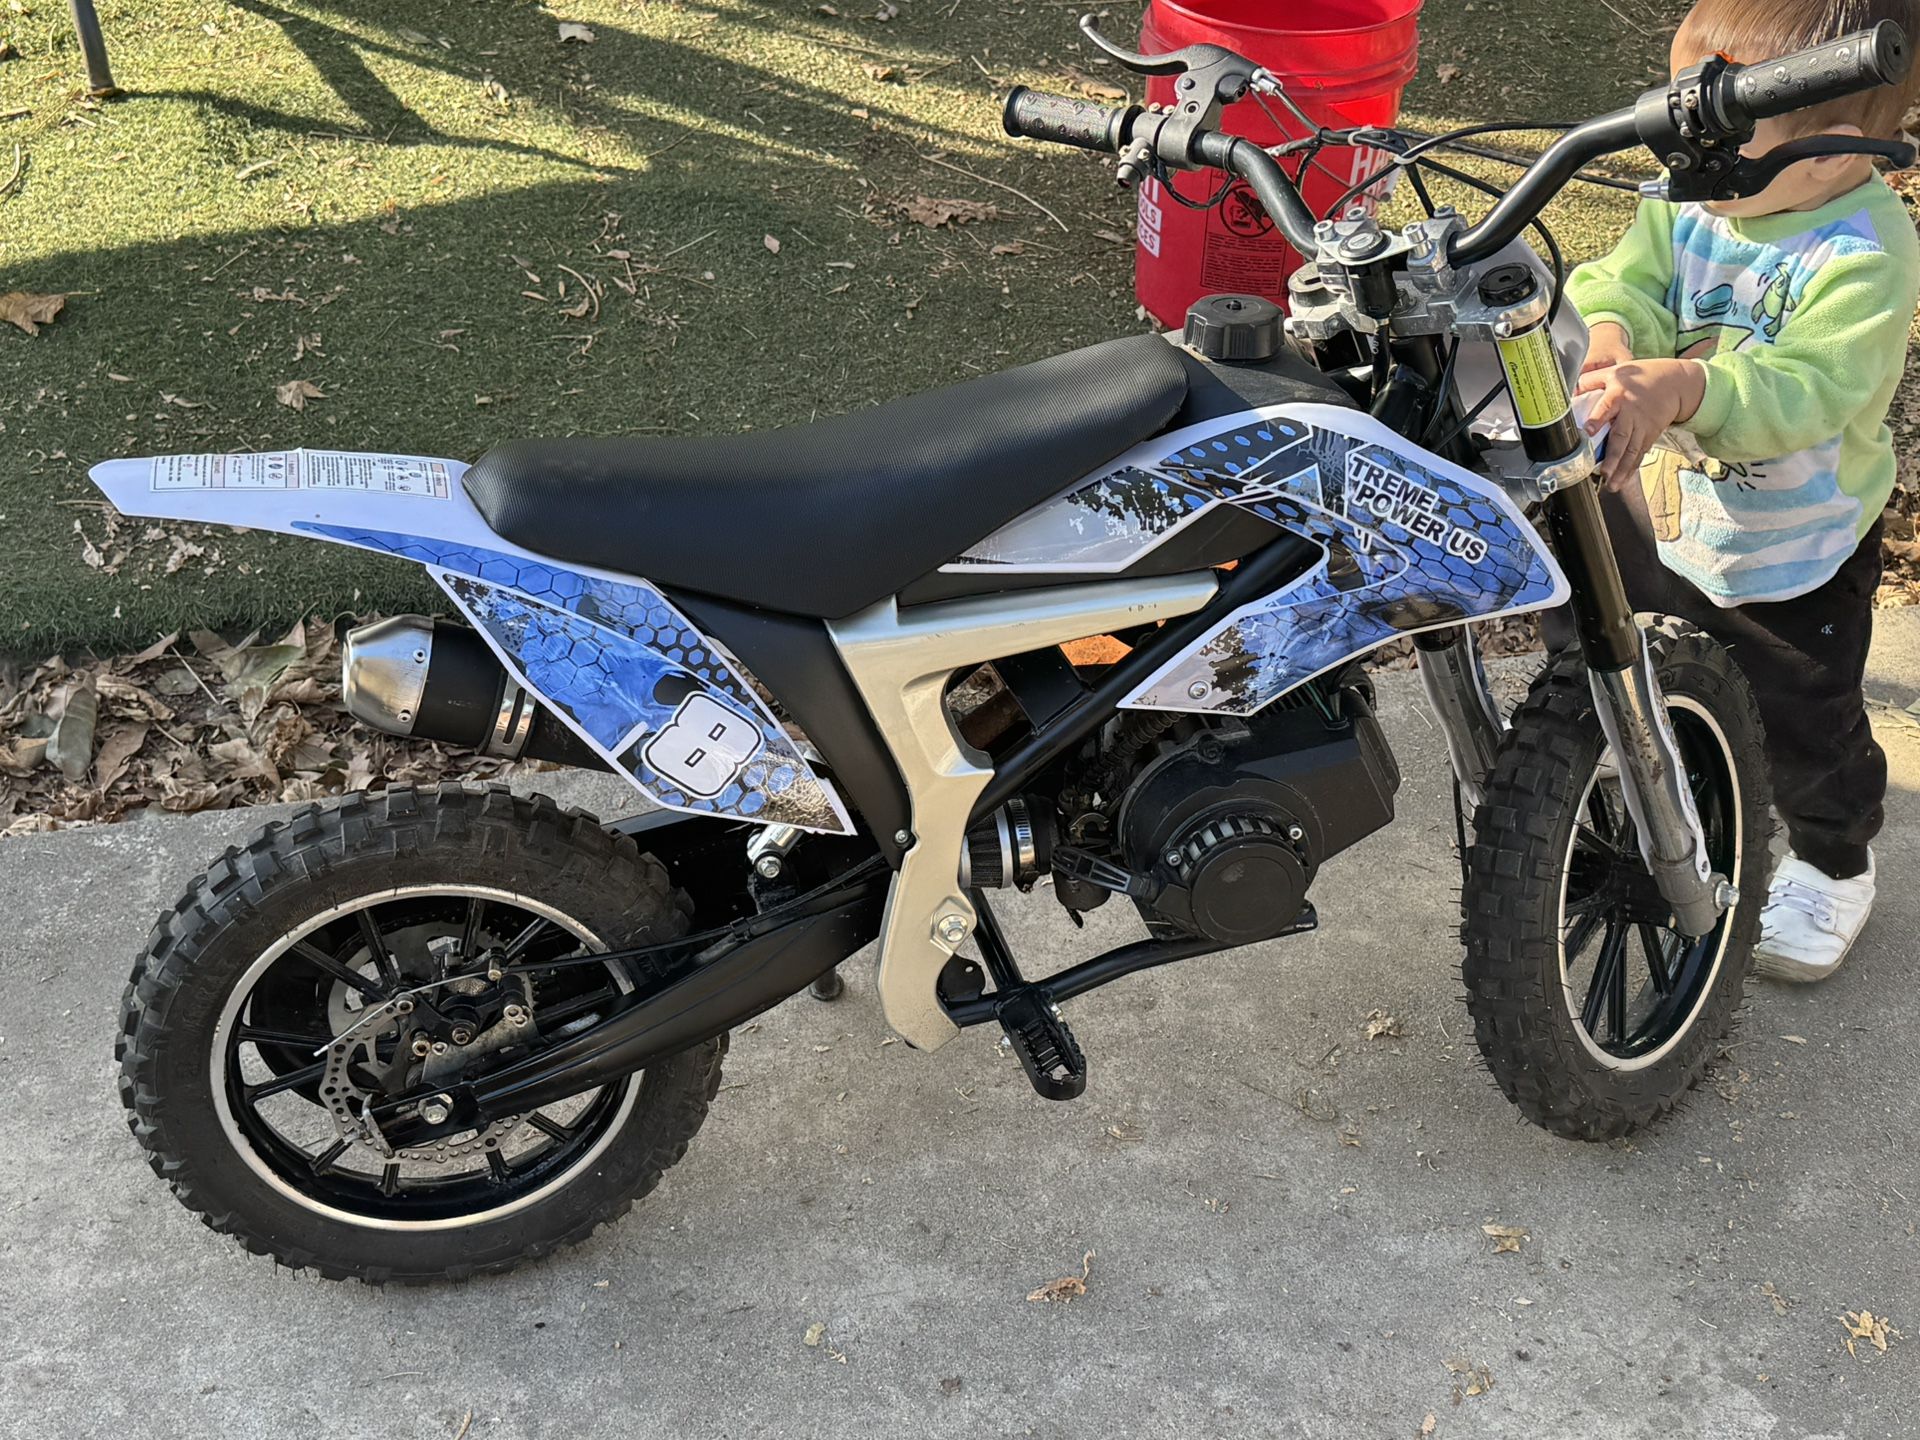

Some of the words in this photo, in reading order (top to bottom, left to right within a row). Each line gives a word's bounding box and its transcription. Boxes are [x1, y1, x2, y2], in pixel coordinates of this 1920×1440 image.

[1351, 456, 1436, 508] TREME
[1355, 486, 1446, 543] POWER
[1450, 531, 1485, 562] US
[644, 692, 763, 797] 8
